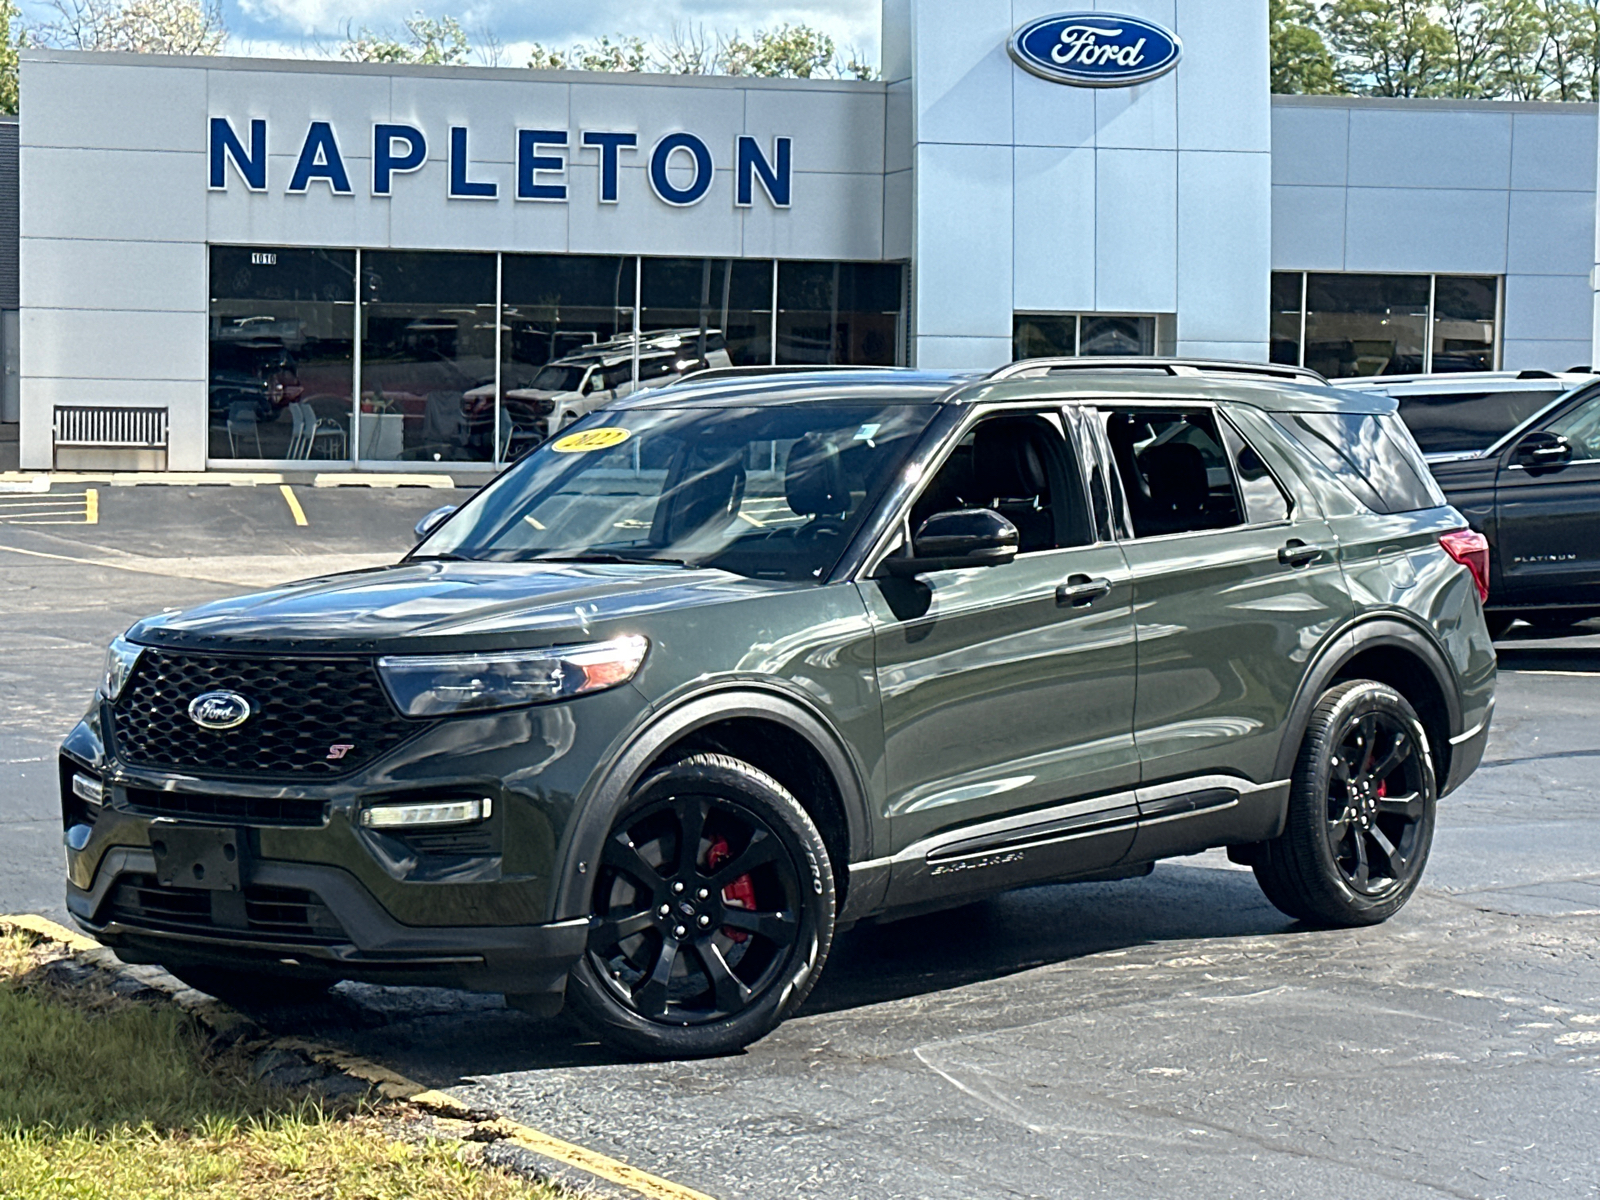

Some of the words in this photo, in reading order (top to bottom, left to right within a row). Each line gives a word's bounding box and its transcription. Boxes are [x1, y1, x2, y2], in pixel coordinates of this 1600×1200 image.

[1051, 25, 1147, 66] Ford
[207, 116, 793, 208] NAPLETON
[252, 253, 276, 264] 1010
[1513, 553, 1577, 563] PLATINUM
[197, 698, 235, 720] Ford
[326, 744, 355, 759] ST
